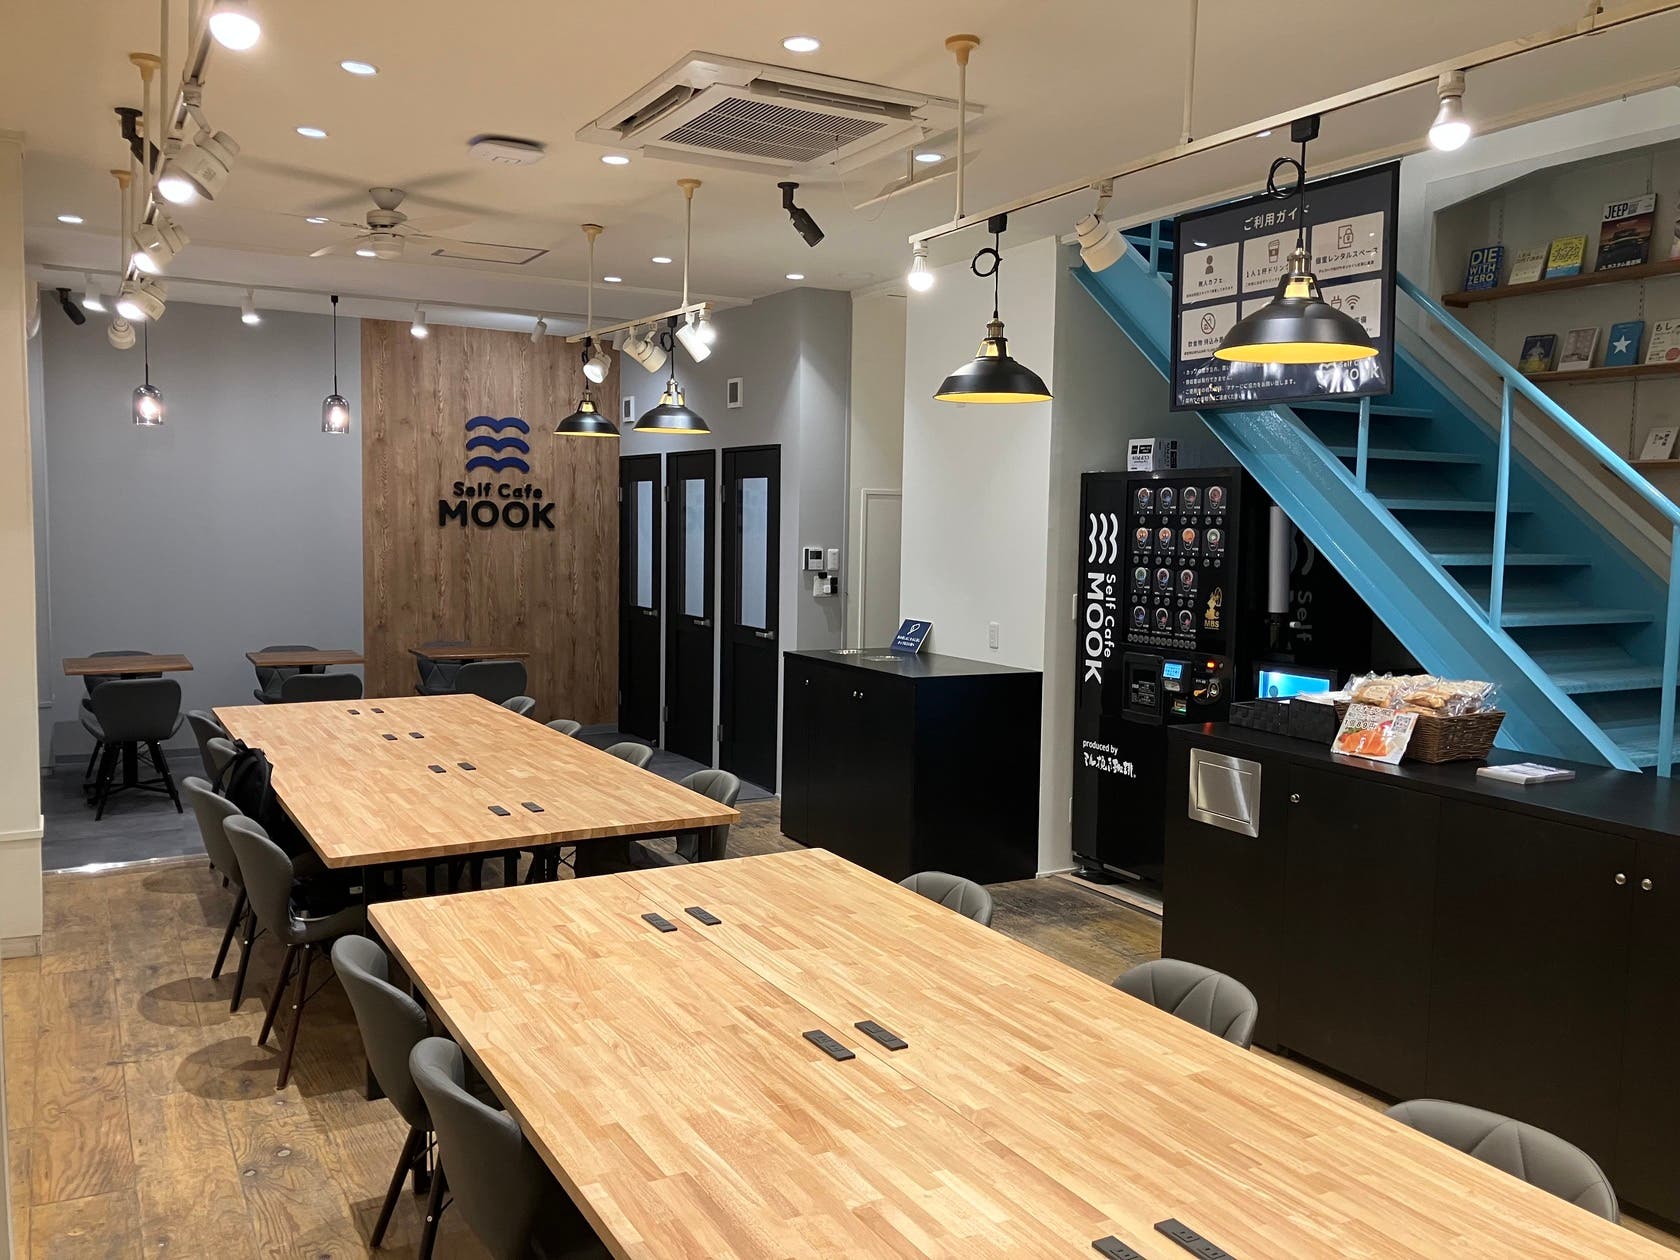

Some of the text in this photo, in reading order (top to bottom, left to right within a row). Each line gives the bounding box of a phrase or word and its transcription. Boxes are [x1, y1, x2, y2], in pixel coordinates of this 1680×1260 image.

[1605, 203, 1629, 219] JEEP
[1471, 247, 1499, 266] DIE
[1469, 263, 1496, 275] WITH
[1468, 273, 1494, 285] ZERO
[453, 481, 543, 499] Self Cafe
[439, 499, 556, 529] MOOK
[1104, 573, 1117, 658] Self Cafe
[1084, 572, 1105, 685] MOOK
[1082, 740, 1119, 756] produced by
